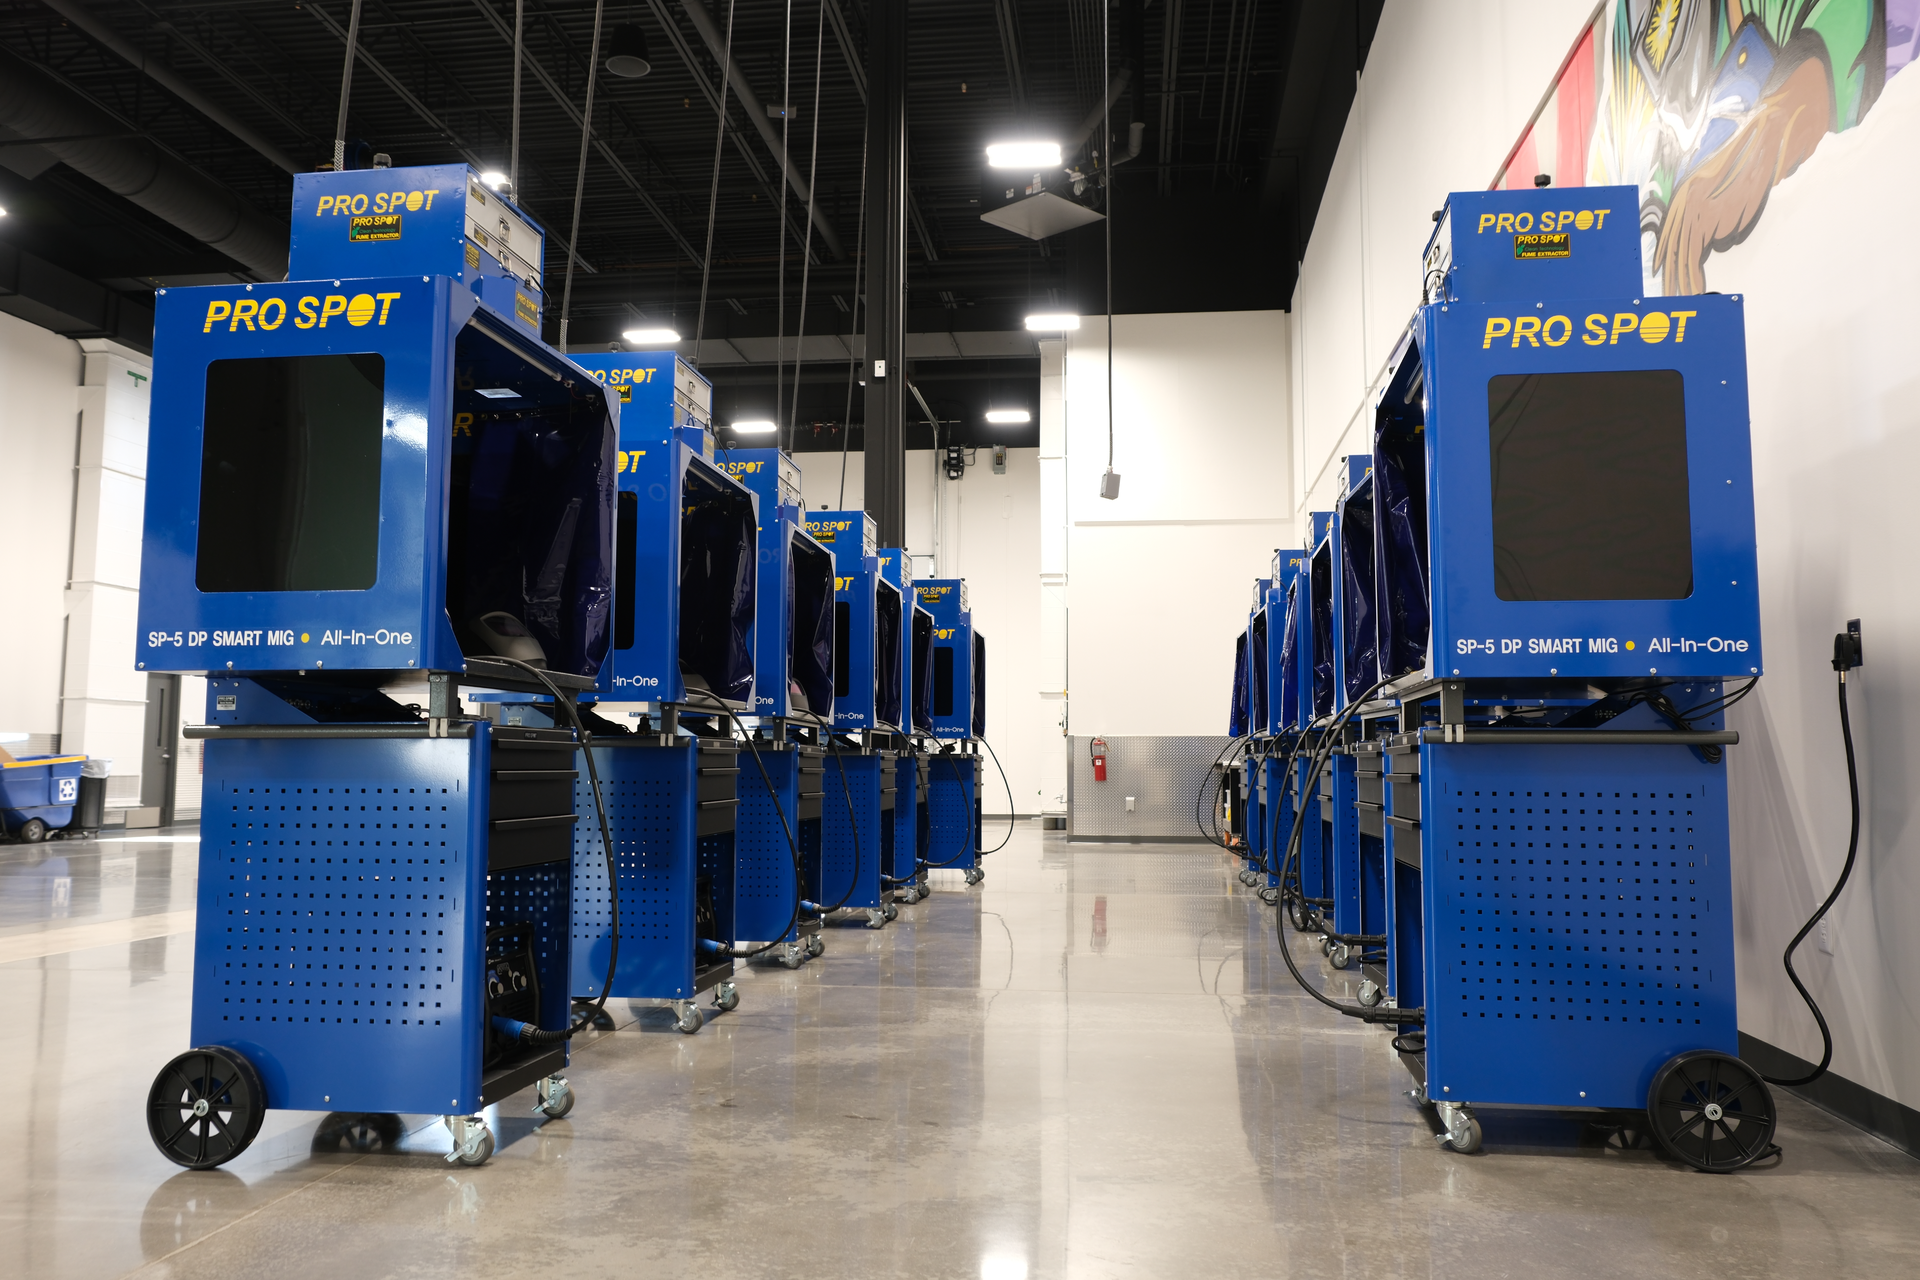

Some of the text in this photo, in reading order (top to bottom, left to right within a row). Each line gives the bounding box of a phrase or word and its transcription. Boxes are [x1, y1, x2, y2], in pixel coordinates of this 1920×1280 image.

[316, 189, 440, 217] PRO SPOT
[352, 216, 399, 226] PRO SPOT
[1477, 209, 1611, 234] PRO SPOT
[1517, 234, 1567, 245] PRO SPOT
[203, 292, 401, 333] PRO SPOT
[1482, 310, 1698, 349] PRO SPOT
[609, 368, 657, 384] SPOT
[728, 461, 765, 474] SPOT
[822, 521, 852, 531] SPOT
[930, 586, 953, 594] SPOT
[148, 628, 413, 647] SP-5 DP SMART MIG All-In-One
[1456, 636, 1749, 655] SP-5 DP SMART MIG All-In-One
